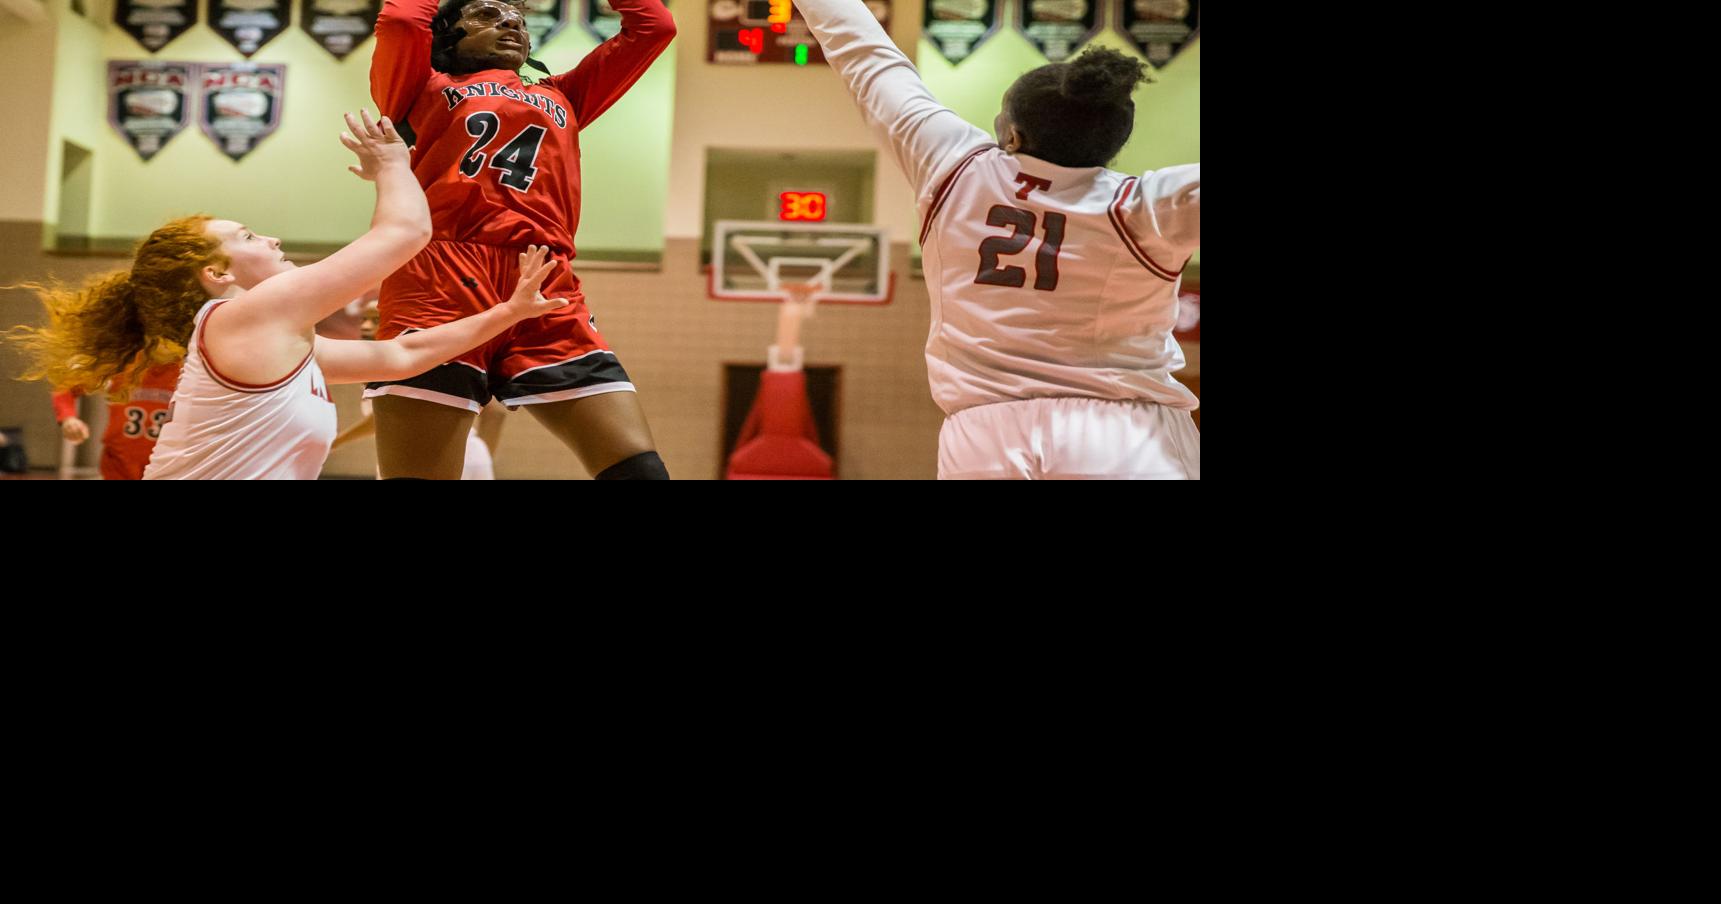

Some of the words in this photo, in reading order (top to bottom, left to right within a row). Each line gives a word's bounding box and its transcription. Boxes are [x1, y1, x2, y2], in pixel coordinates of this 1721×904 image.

[442, 82, 566, 128] KNIGHTS
[459, 111, 547, 193] 24
[779, 191, 826, 222] 30
[1014, 172, 1052, 201] T
[974, 204, 1067, 291] 21
[123, 406, 168, 440] 33
